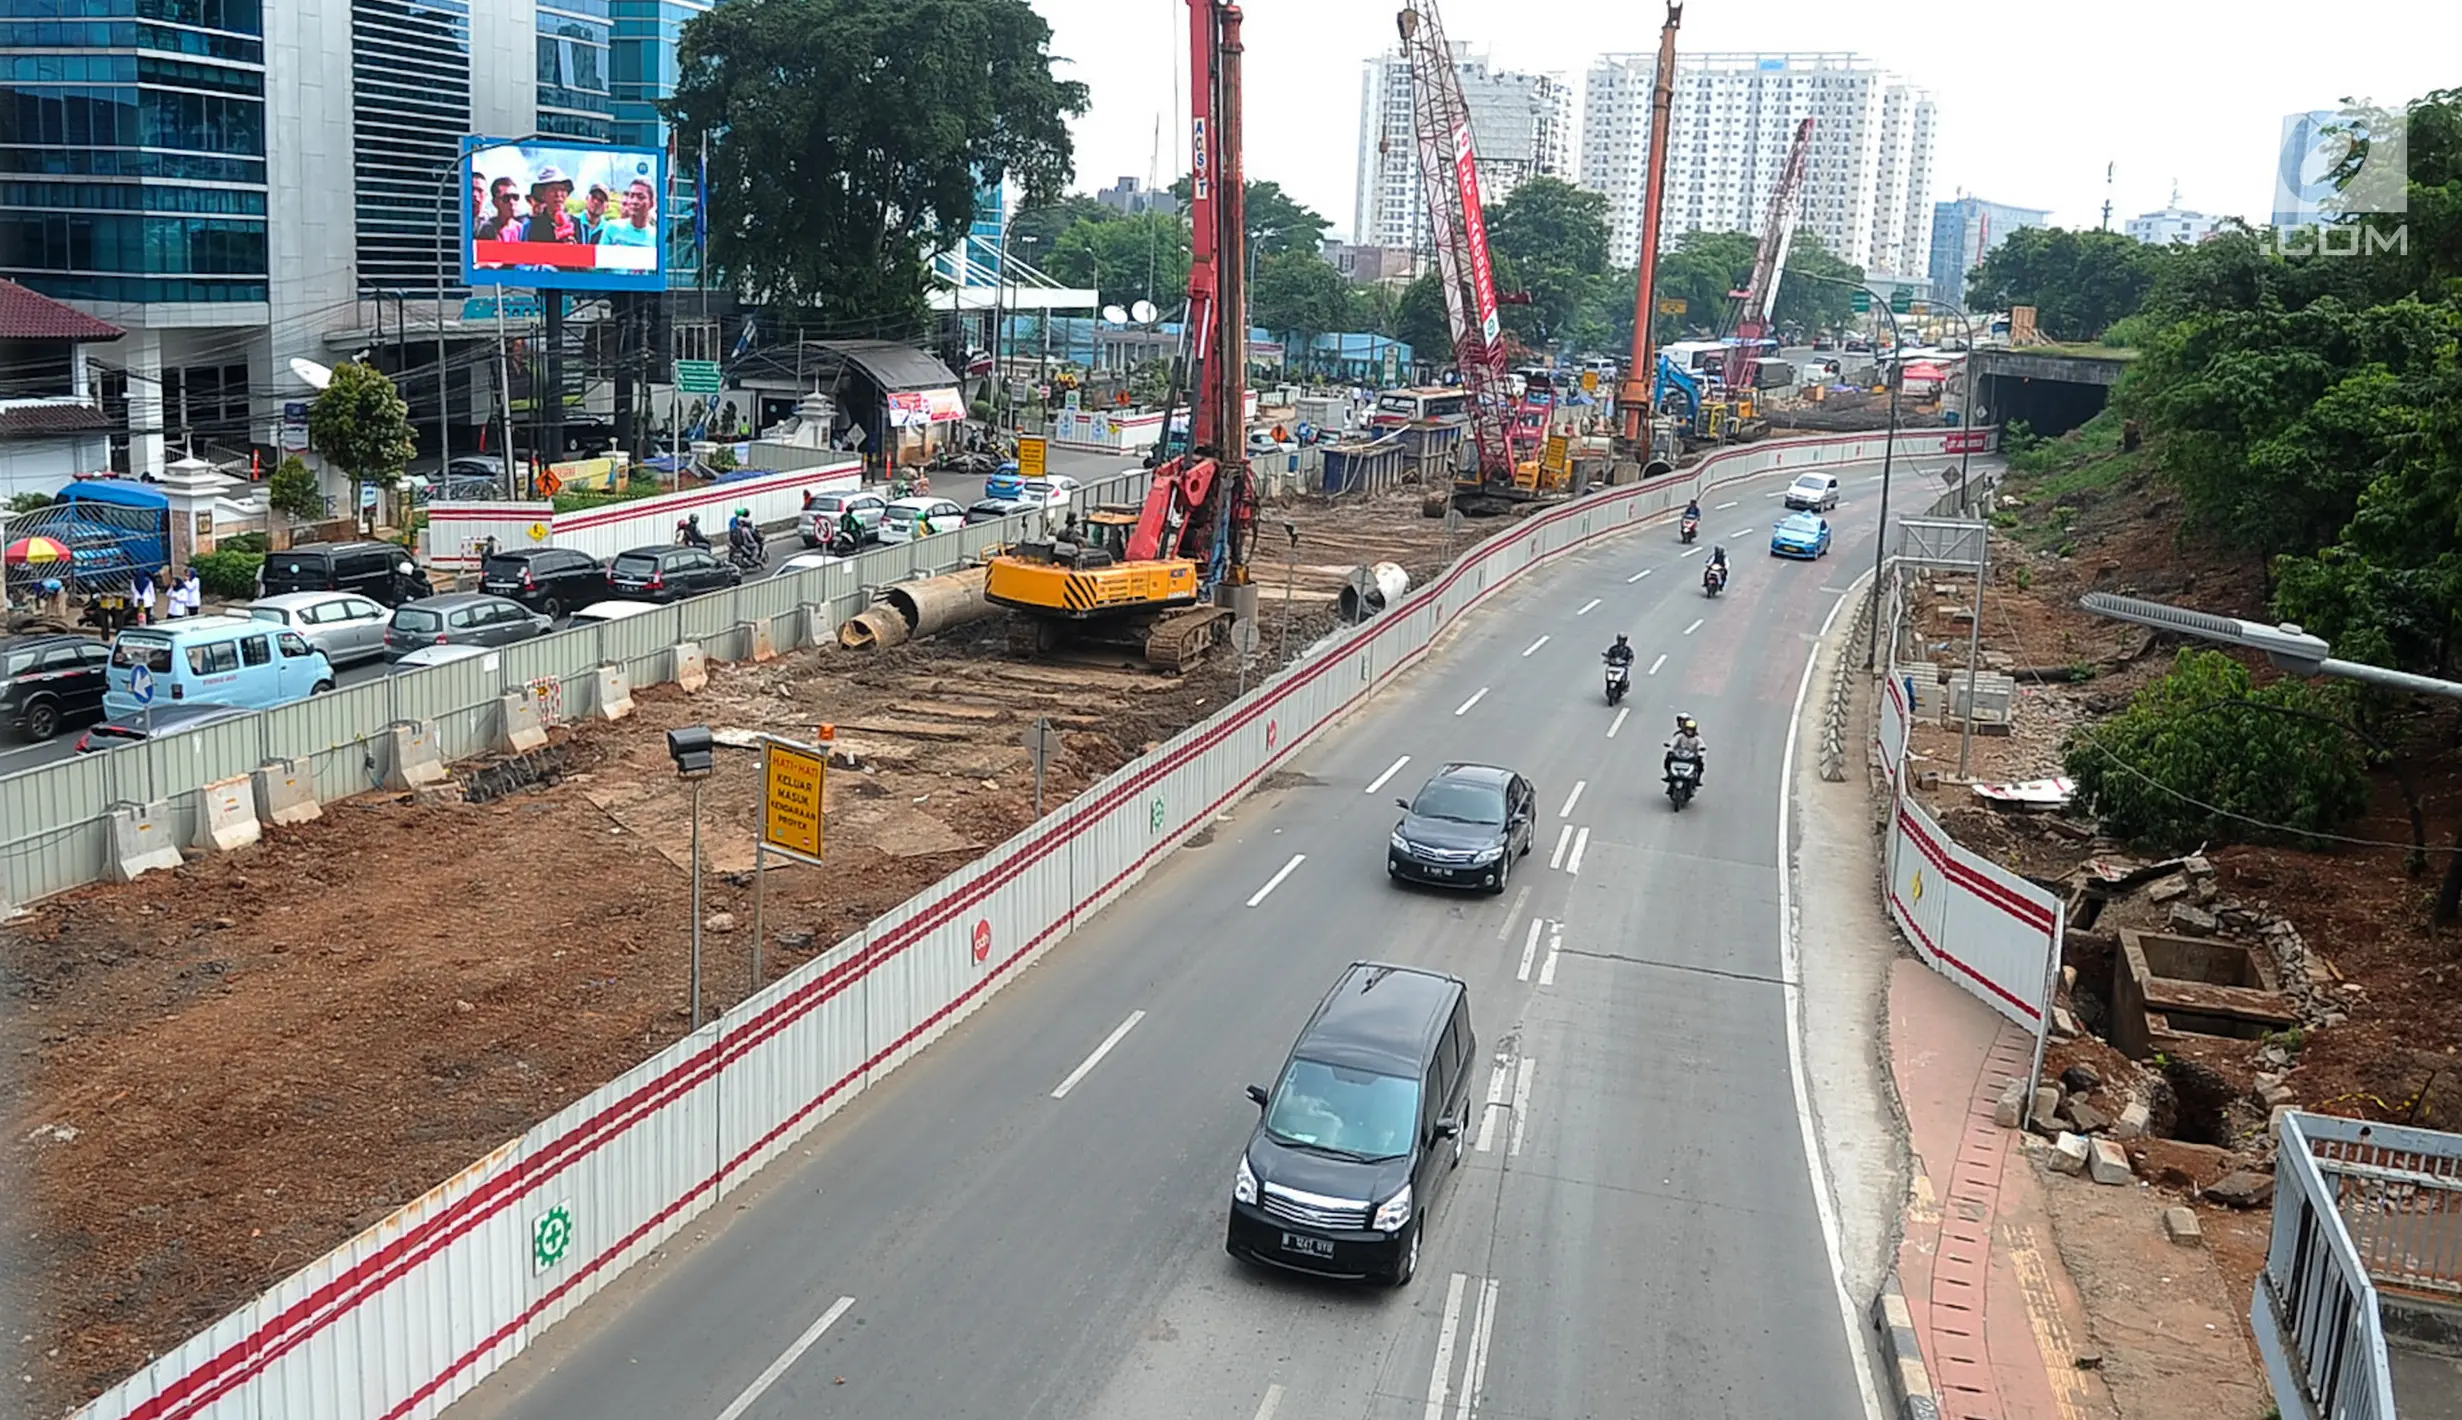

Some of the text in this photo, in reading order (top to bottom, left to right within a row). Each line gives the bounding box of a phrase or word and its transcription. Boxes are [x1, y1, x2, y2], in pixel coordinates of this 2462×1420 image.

[772, 756, 819, 779] HATI-HATI
[776, 773, 812, 792] KELUAR
[777, 788, 809, 806] MASUK
[771, 800, 816, 821] KENDARAAN
[778, 814, 808, 831] PROYEK
